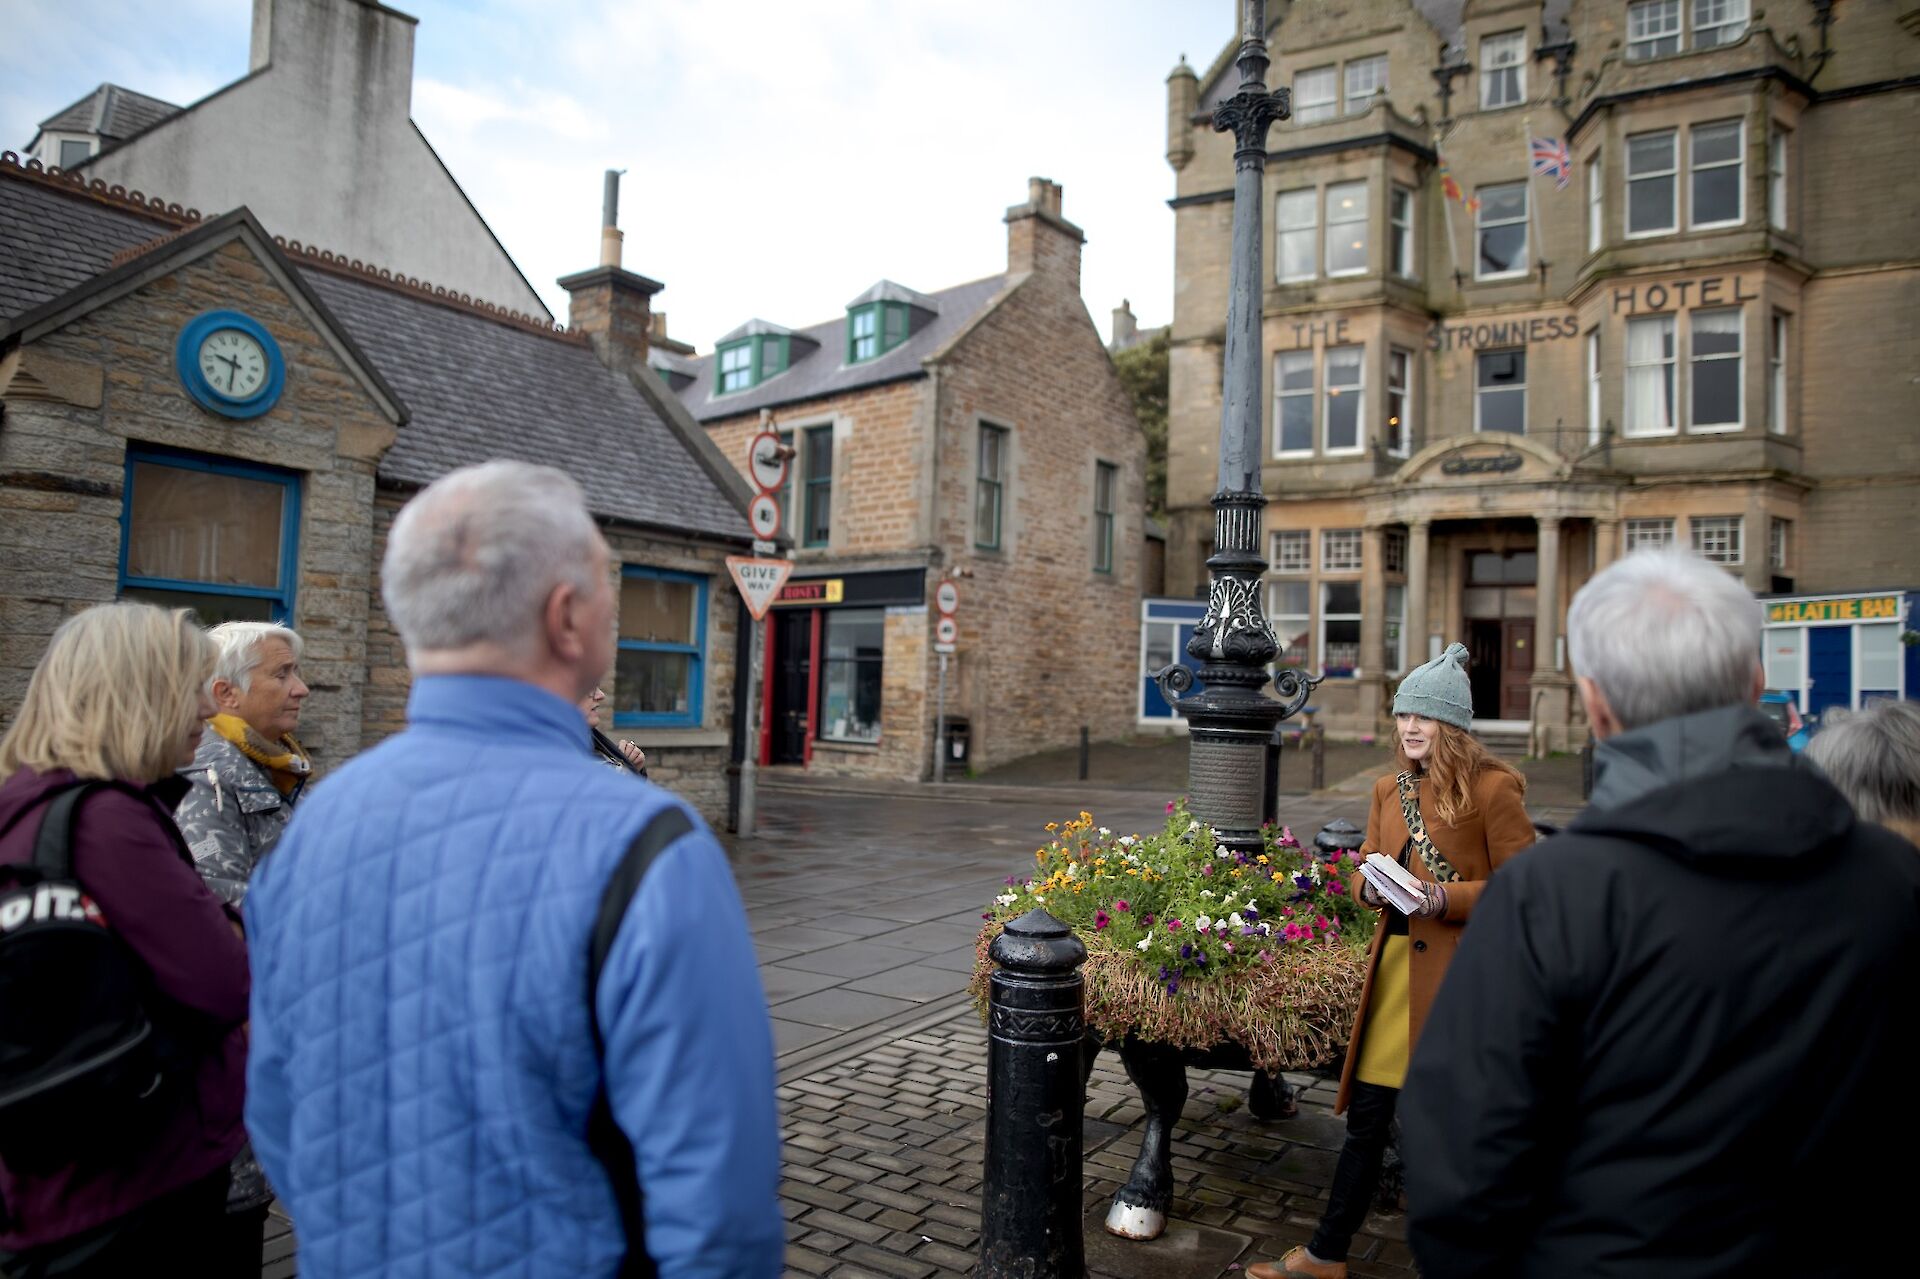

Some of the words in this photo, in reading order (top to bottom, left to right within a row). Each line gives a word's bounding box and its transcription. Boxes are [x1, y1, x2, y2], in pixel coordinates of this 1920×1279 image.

[1291, 319, 1350, 348] THE
[1425, 315, 1579, 351] STROMNESS
[1613, 275, 1758, 314] HOTEL
[741, 566, 777, 580] GIVE
[747, 582, 770, 592] WAY
[1784, 601, 1857, 622] FLATTIE
[1861, 597, 1896, 618] BAR
